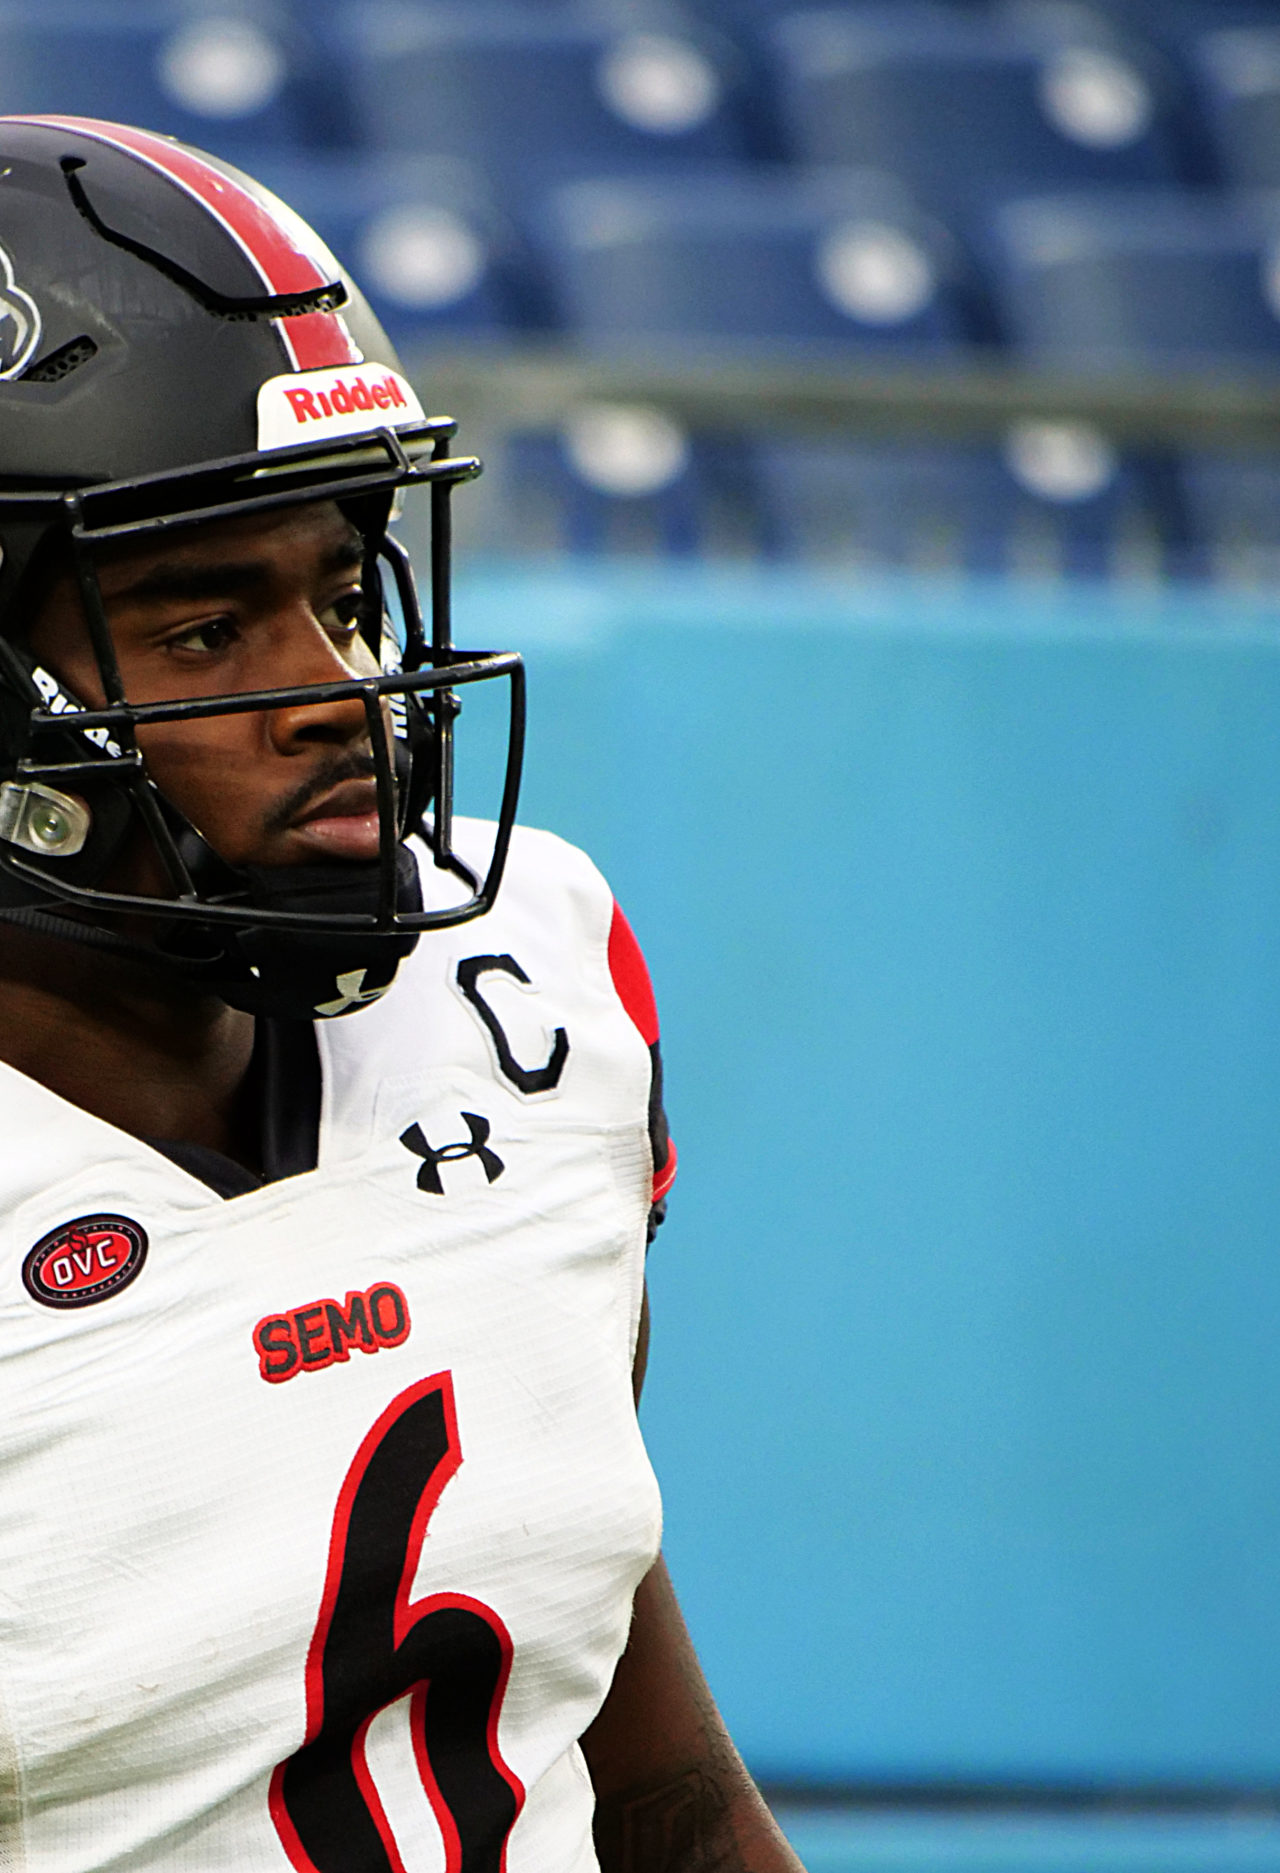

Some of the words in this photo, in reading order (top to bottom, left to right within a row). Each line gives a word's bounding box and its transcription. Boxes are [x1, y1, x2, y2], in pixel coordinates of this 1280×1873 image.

[283, 375, 407, 423] Riddell
[456, 953, 570, 1095] C
[52, 1239, 117, 1286] OVC
[254, 1283, 410, 1382] SEMO
[268, 1370, 526, 1873] 6
